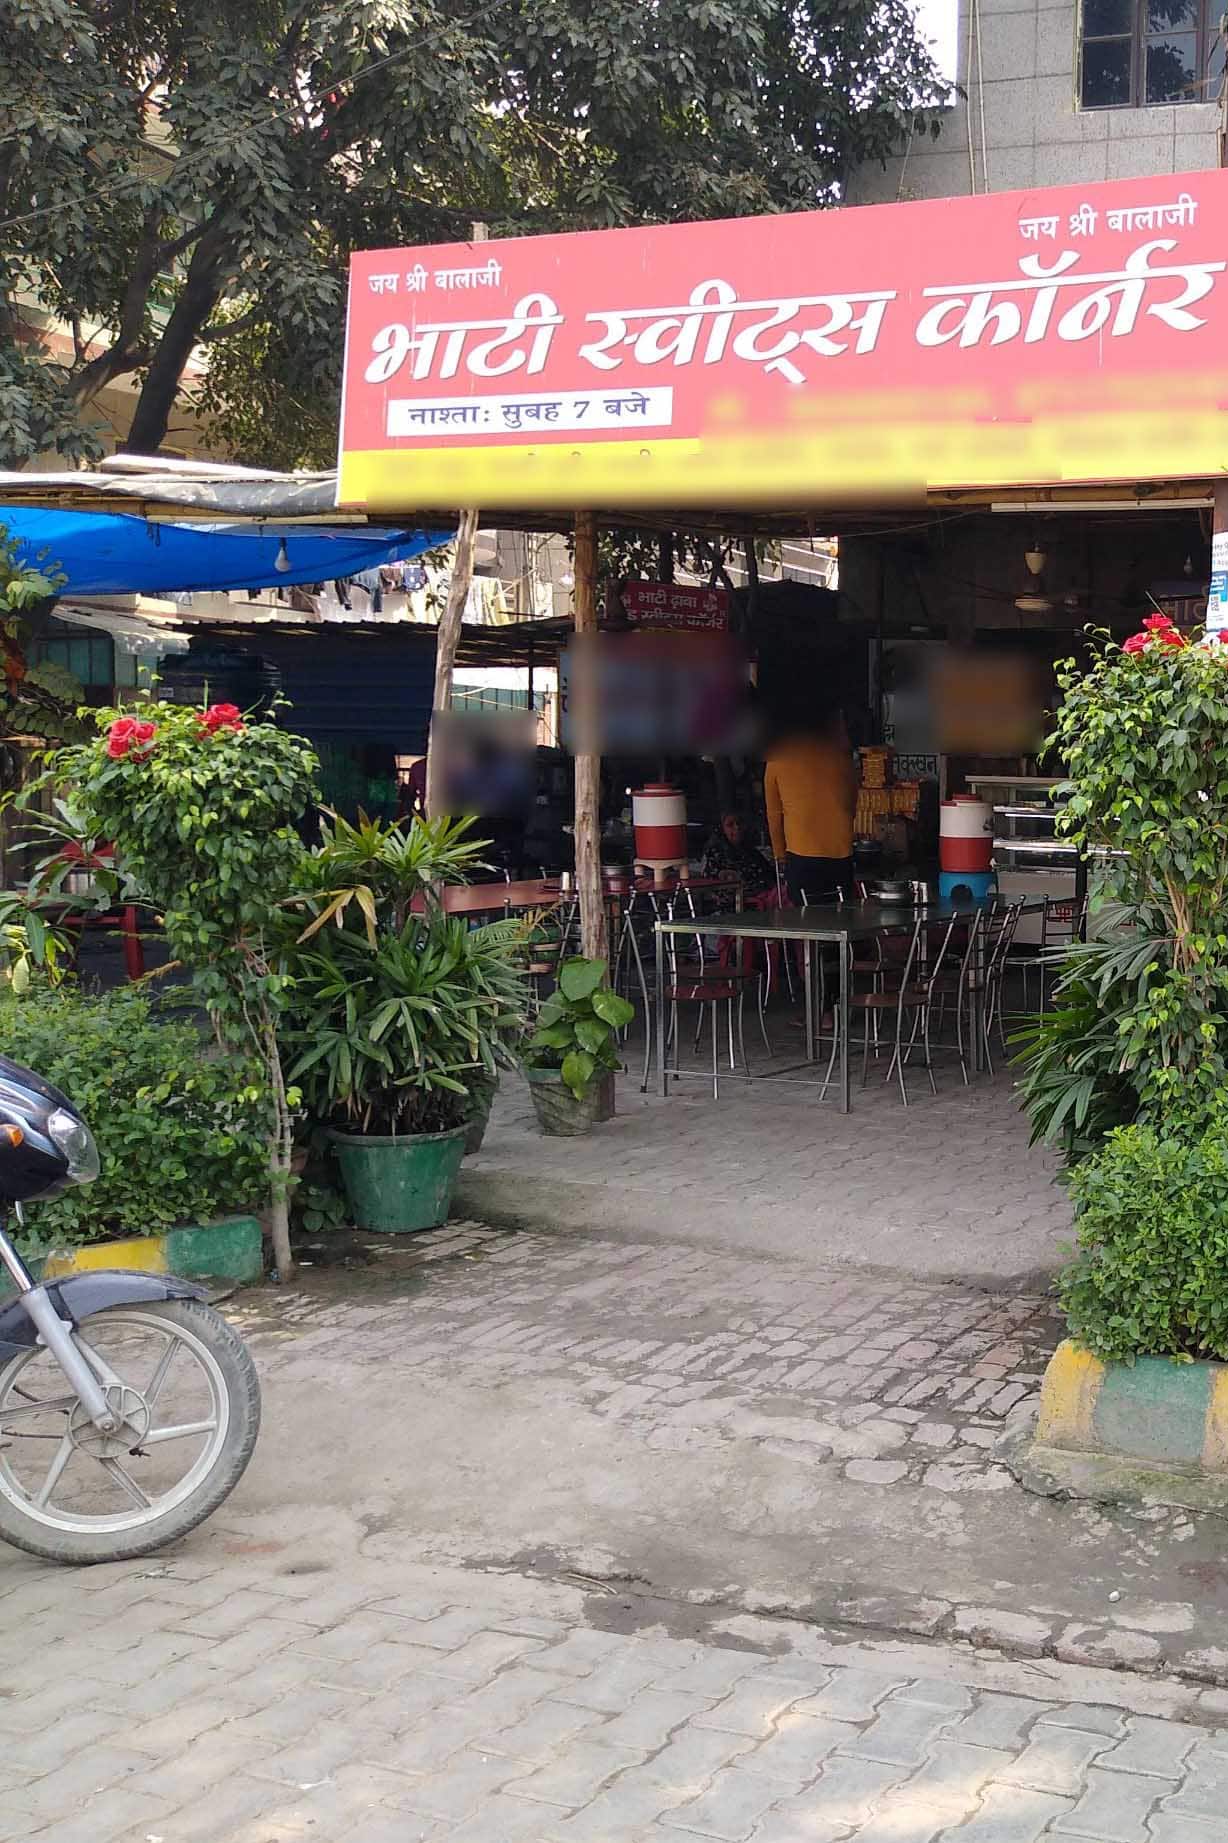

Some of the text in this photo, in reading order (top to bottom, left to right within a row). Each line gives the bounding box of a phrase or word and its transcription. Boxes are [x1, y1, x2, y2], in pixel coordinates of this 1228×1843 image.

[1018, 192, 1199, 241] जय श्री बालाजी
[368, 257, 503, 295] जय श्री बालाजी
[364, 292, 565, 384] भाटी
[578, 278, 898, 385] स्वीट्स
[915, 238, 1228, 348] कॉर्नर
[407, 391, 651, 428] नाश्ता: सुबह 7 बजे
